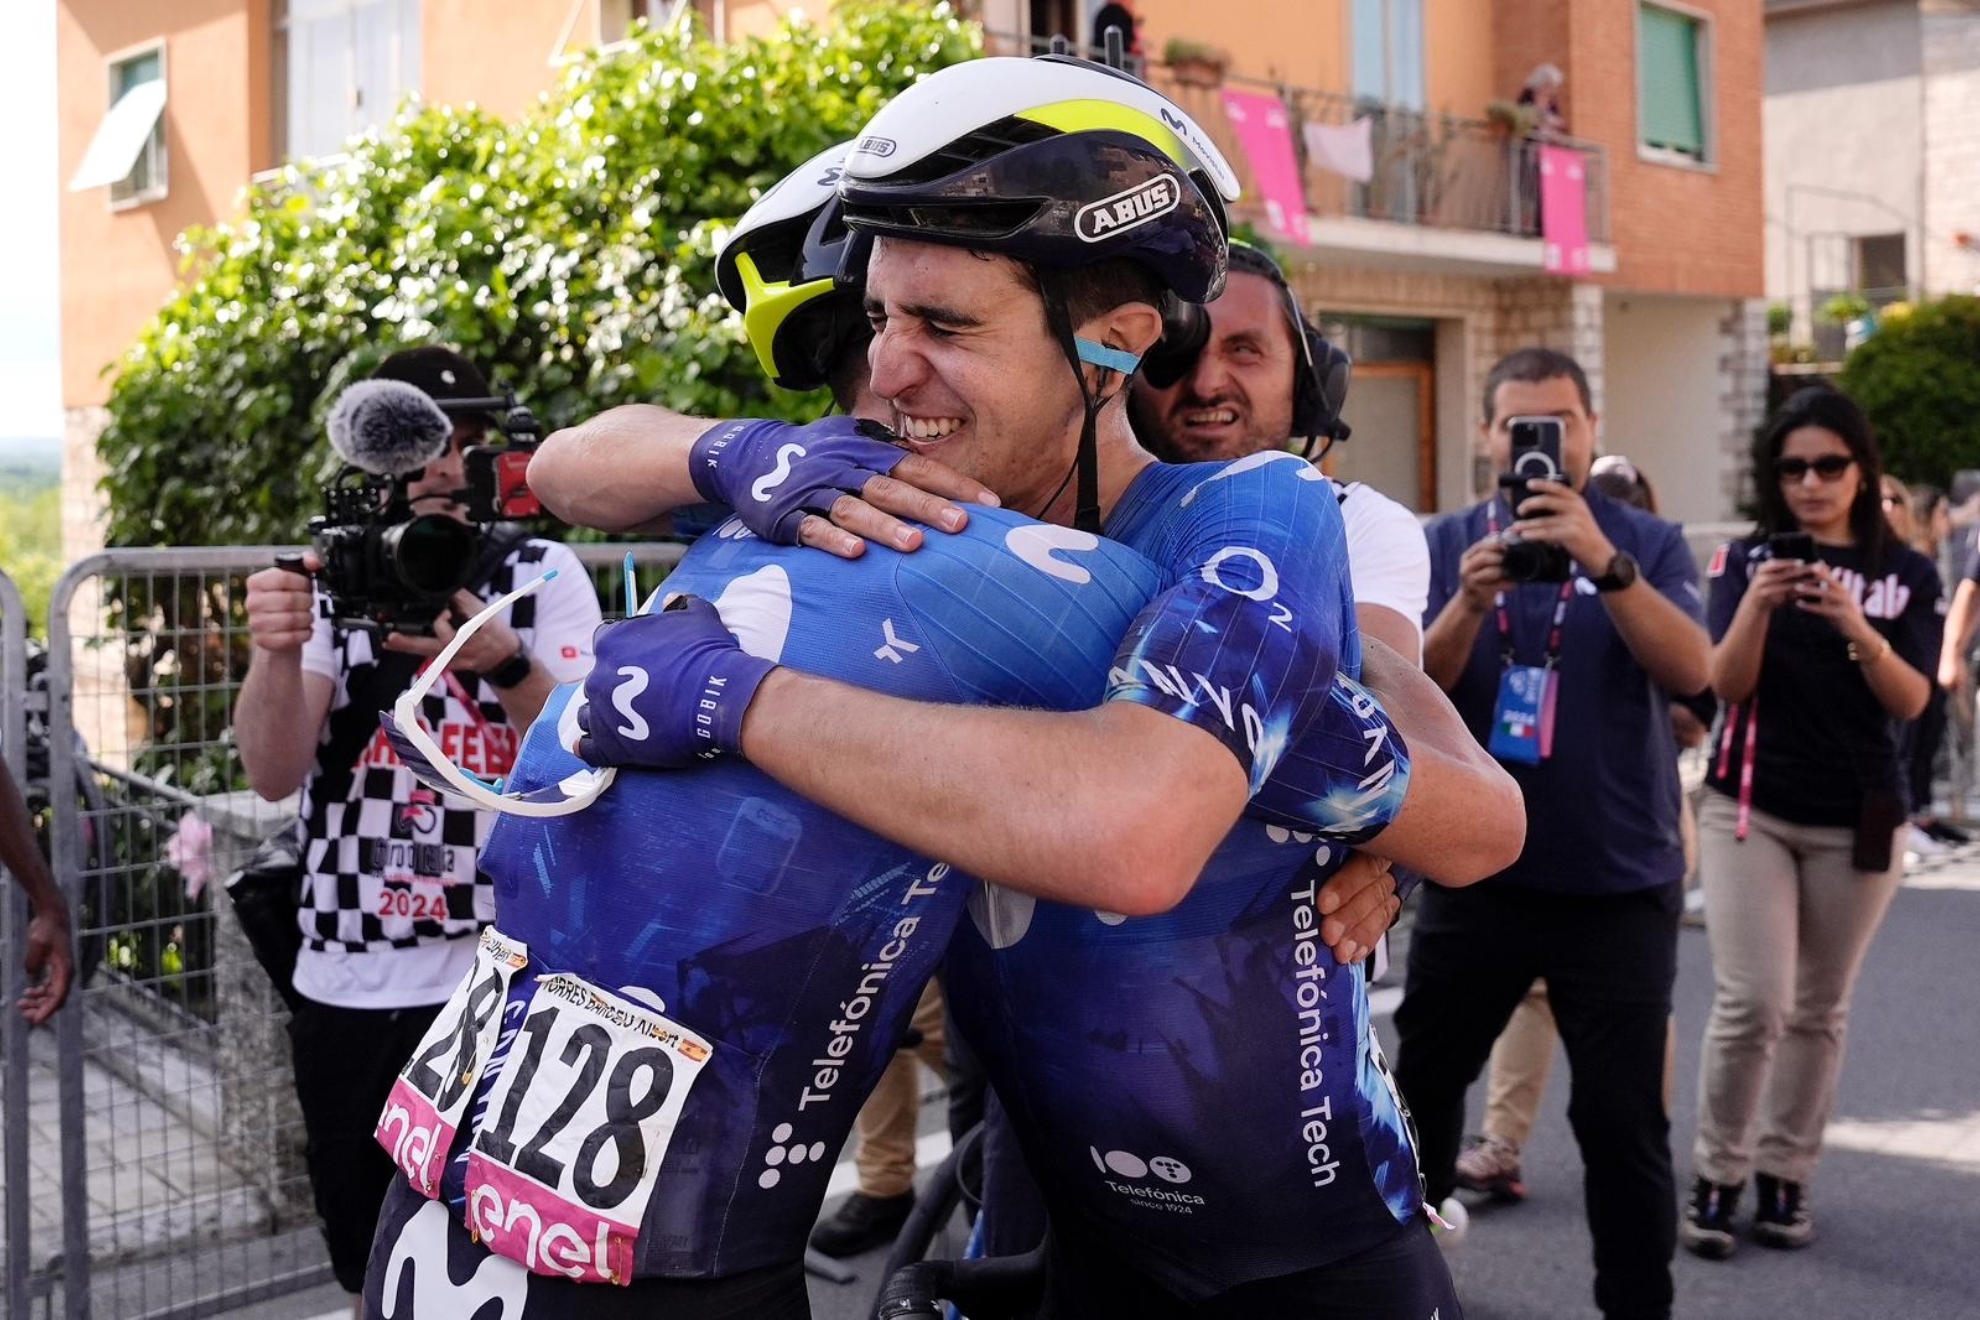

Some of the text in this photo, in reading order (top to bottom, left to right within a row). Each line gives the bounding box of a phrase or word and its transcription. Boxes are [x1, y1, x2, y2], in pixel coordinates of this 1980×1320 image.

[1093, 182, 1171, 234] ABUS
[707, 425, 746, 469] GOBIK
[696, 675, 727, 739] GOBIK
[378, 891, 448, 921] 2024
[406, 956, 503, 1113] 28
[797, 915, 922, 1112] Telefónica
[1290, 879, 1340, 1188] Telefónica Tech
[377, 1104, 443, 1195] nel
[475, 1006, 674, 1210] 128
[472, 1183, 613, 1279] enel
[1104, 1180, 1205, 1205] Telefónica
